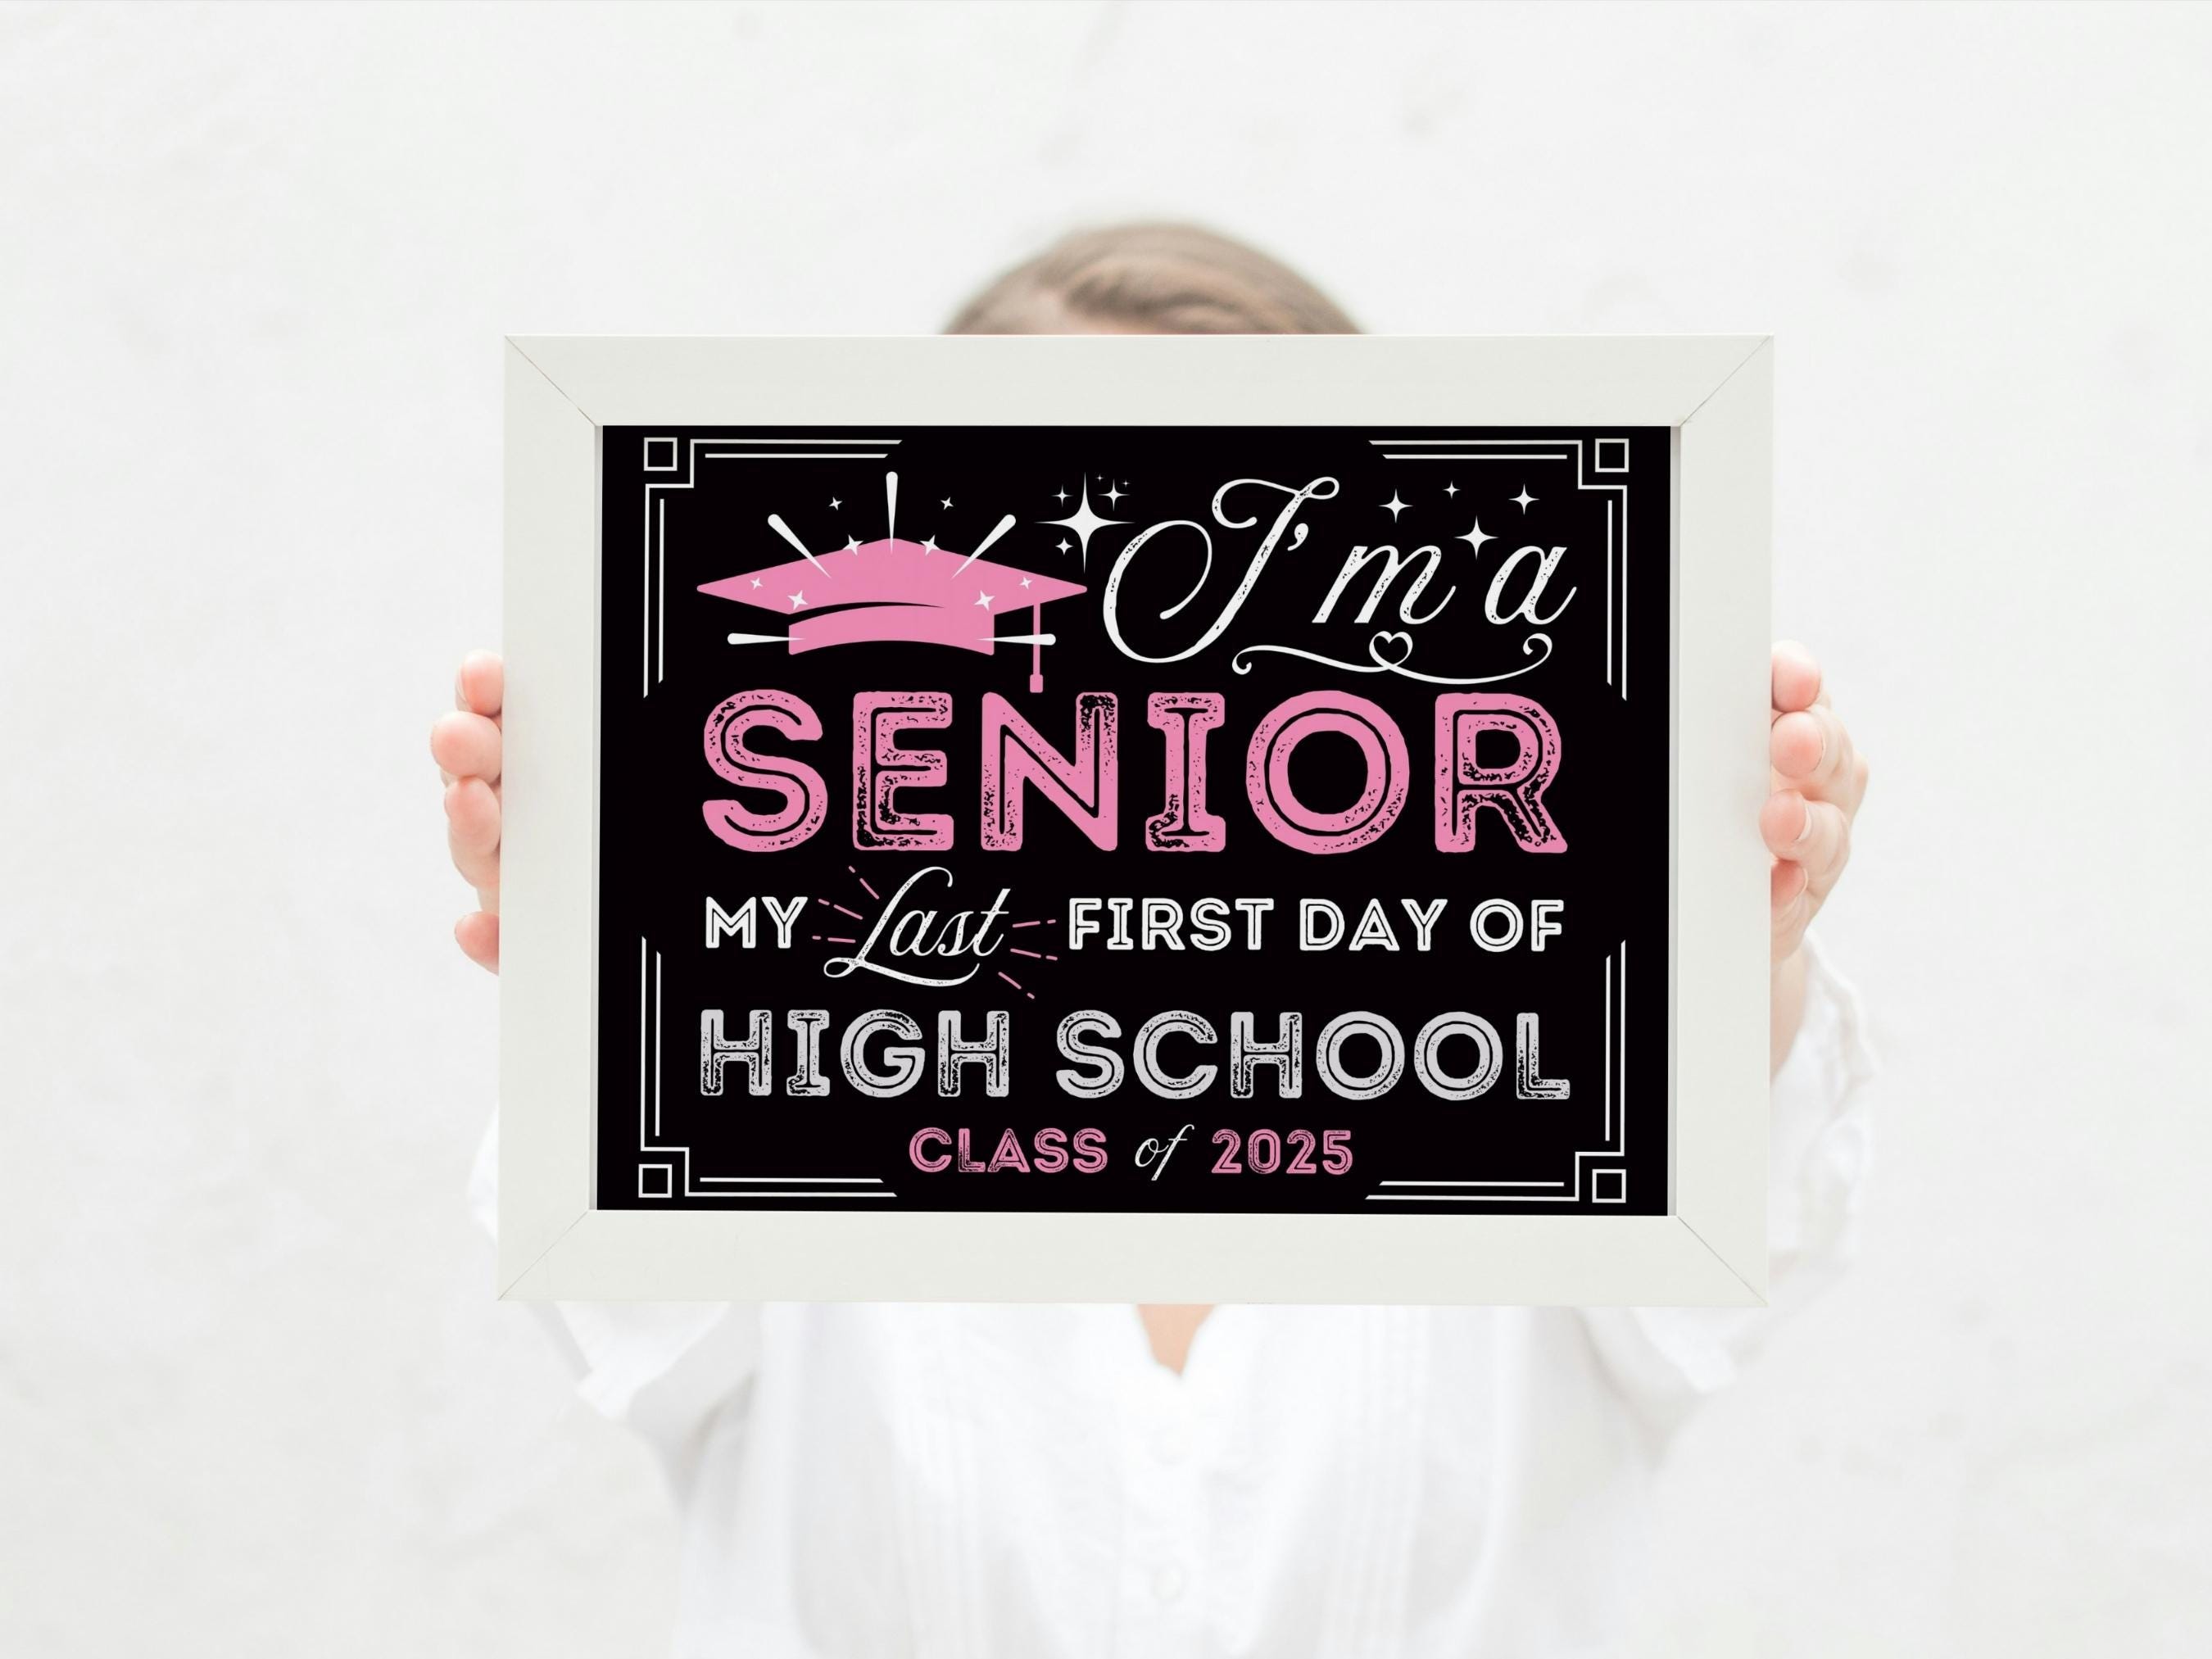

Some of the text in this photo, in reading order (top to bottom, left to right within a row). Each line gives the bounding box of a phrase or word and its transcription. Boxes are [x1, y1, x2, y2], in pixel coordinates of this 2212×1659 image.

[1104, 477, 1577, 663] I'm a
[702, 689, 1567, 854] SENIOR
[705, 866, 1565, 988] MY Last FIRST DAY OF
[700, 1009, 1571, 1100] HIGH SCHOOL
[909, 1123, 1353, 1181] CLASS of 2025
